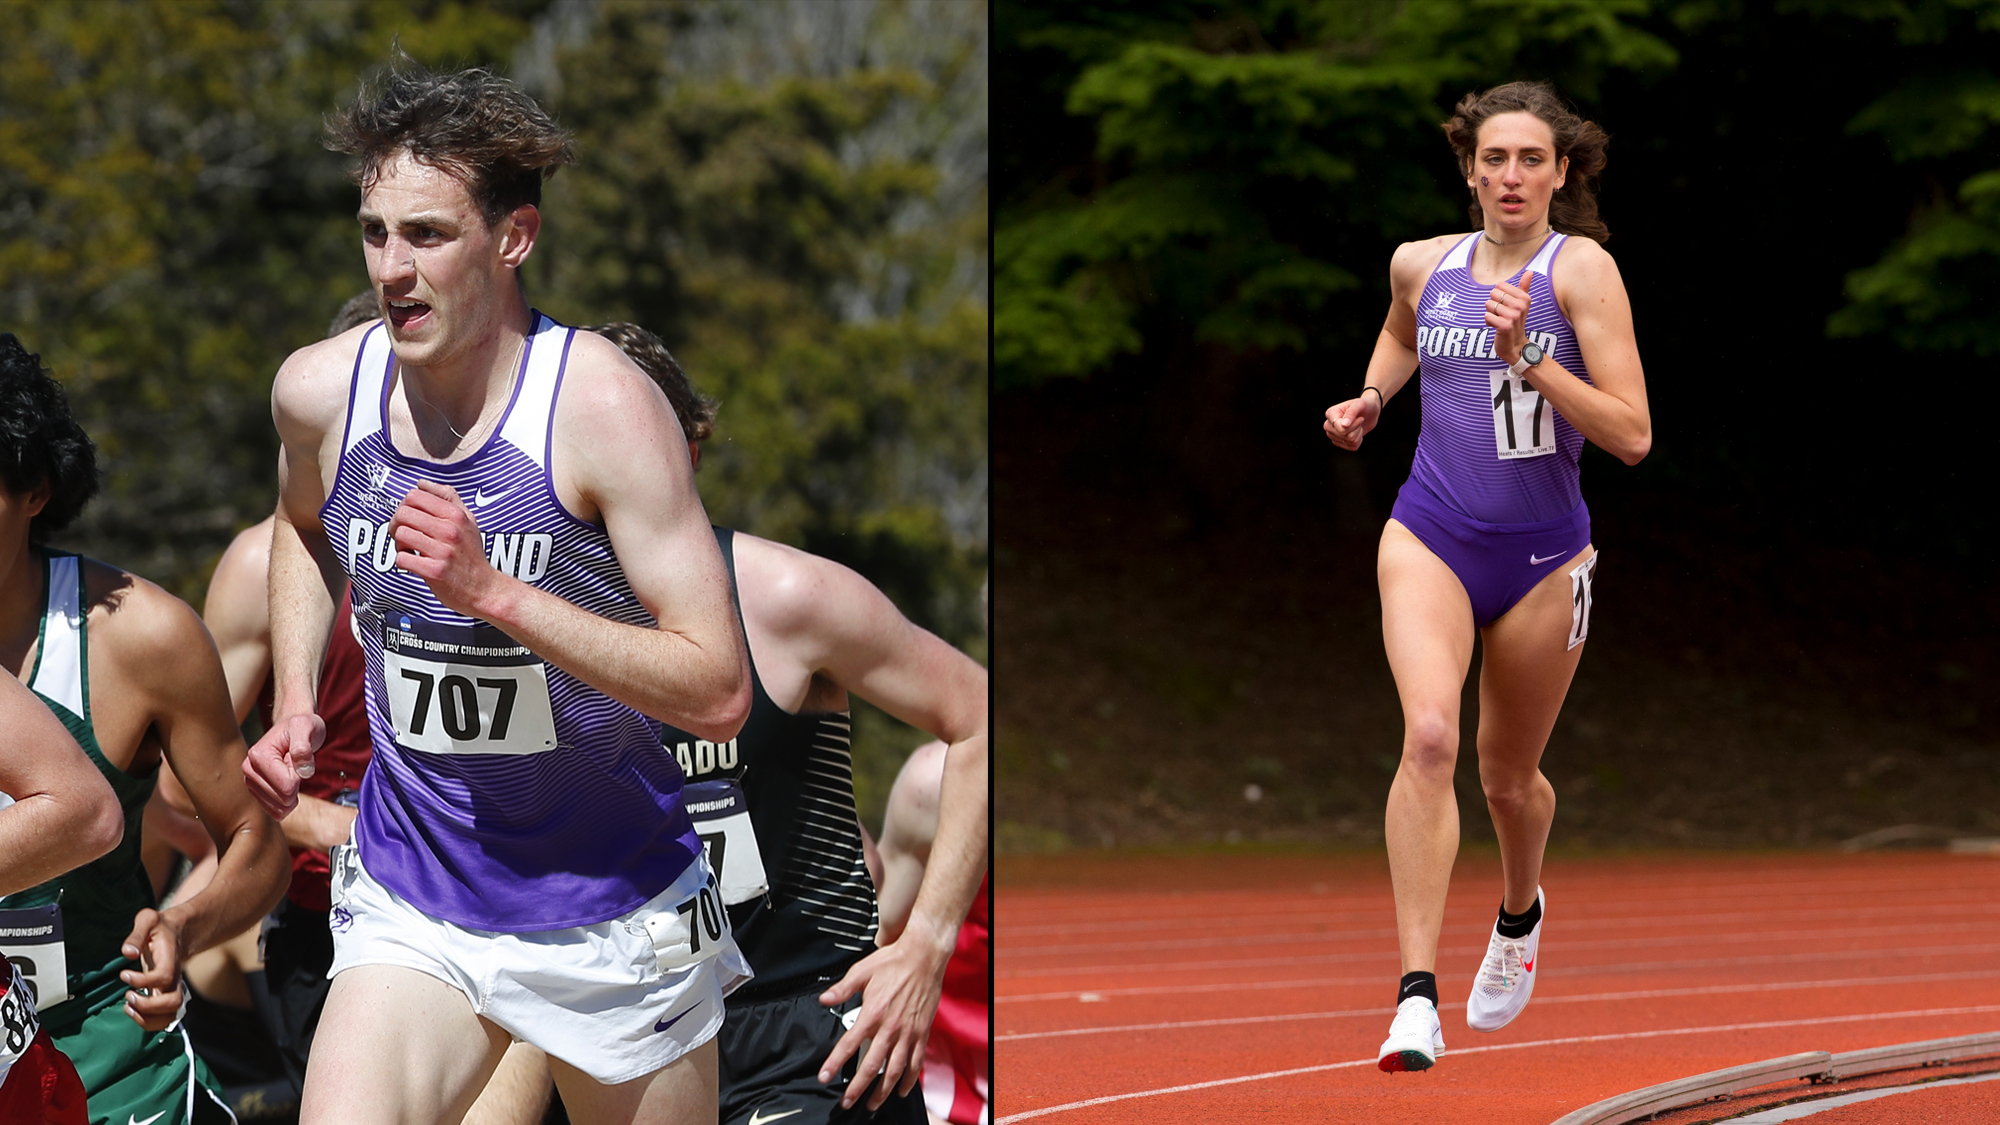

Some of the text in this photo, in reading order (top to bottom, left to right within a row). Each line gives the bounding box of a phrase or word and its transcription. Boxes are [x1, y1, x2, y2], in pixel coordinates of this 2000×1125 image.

[1417, 325, 1558, 363] PORTLD
[1494, 379, 1546, 450] 17
[400, 635, 531, 657] CROSS COUNTRY CHAMPIONSHIPS
[401, 668, 518, 741] 707
[664, 737, 739, 778] ADO
